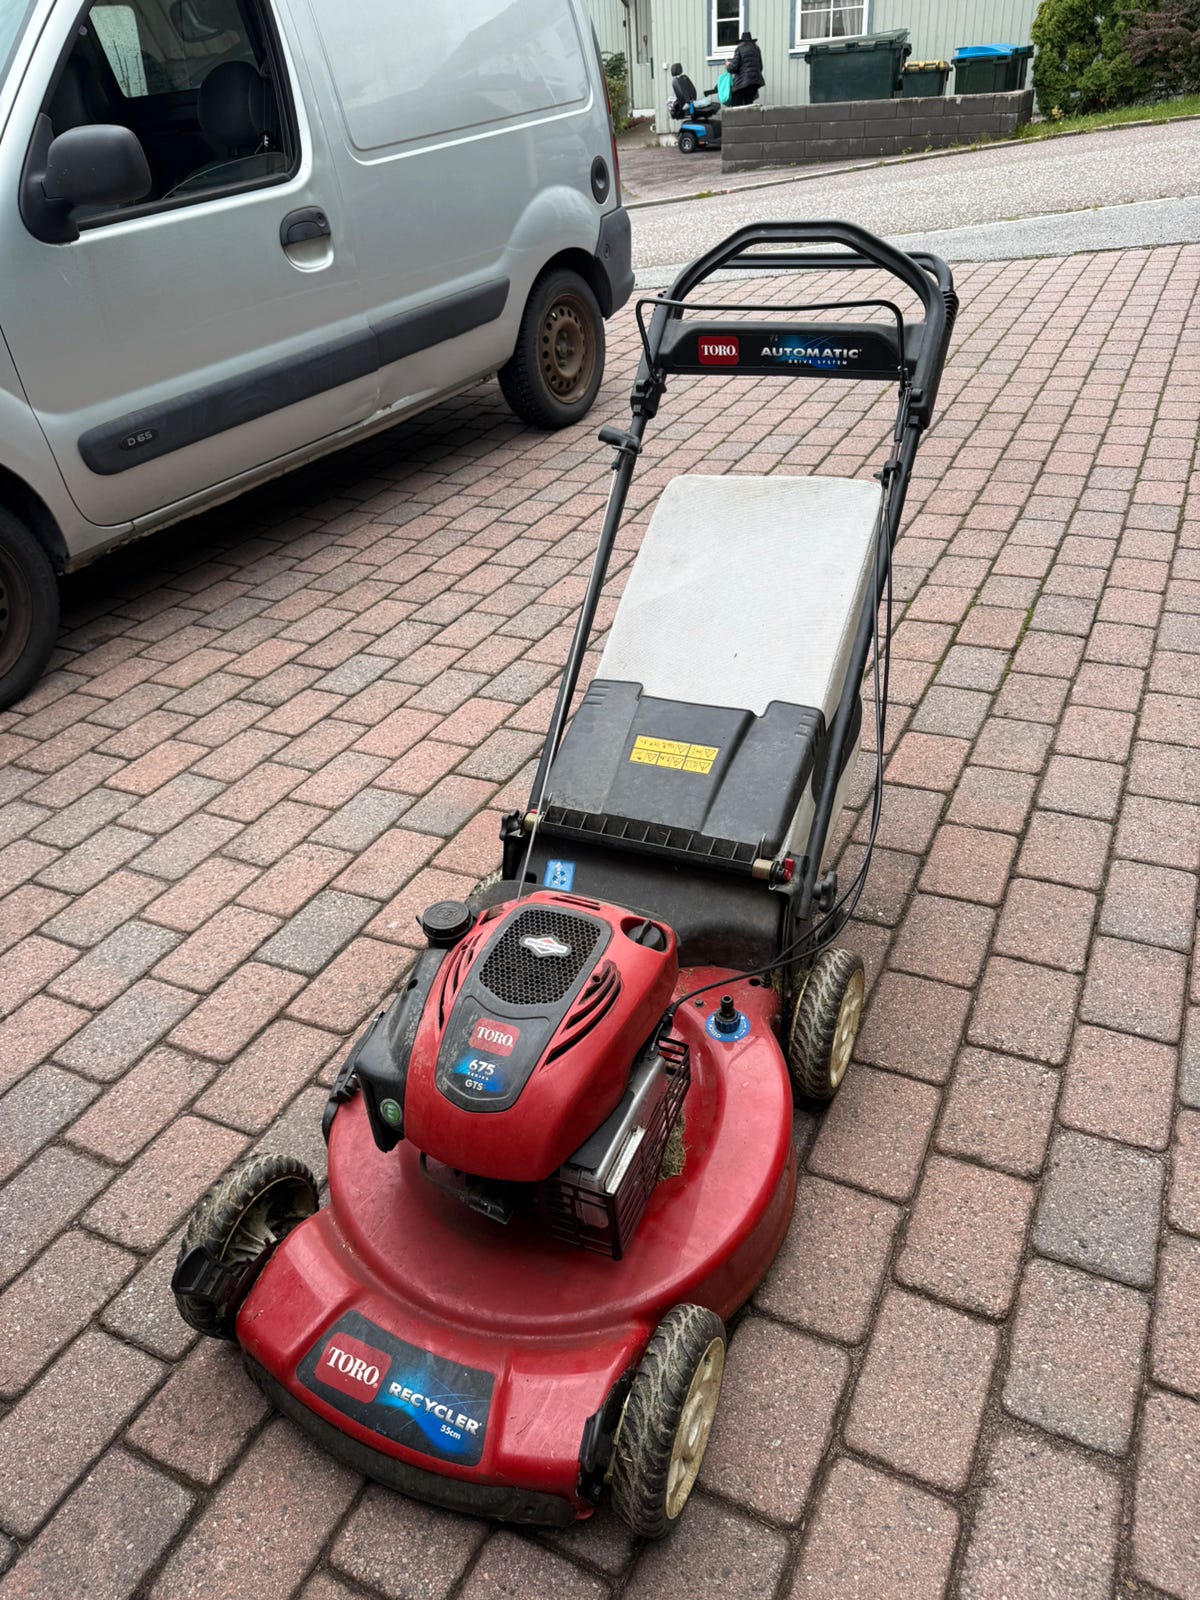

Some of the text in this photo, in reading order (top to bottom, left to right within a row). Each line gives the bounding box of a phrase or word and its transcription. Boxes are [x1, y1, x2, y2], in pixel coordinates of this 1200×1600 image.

[701, 344, 737, 356] TORO
[760, 346, 859, 359] AUTOMATIC
[476, 1026, 513, 1047] TORO
[468, 1059, 496, 1076] 675
[464, 1079, 484, 1091] GTS
[326, 1346, 380, 1386] TORO
[388, 1381, 480, 1435] RECYCLER
[439, 1424, 462, 1440] 55cm
